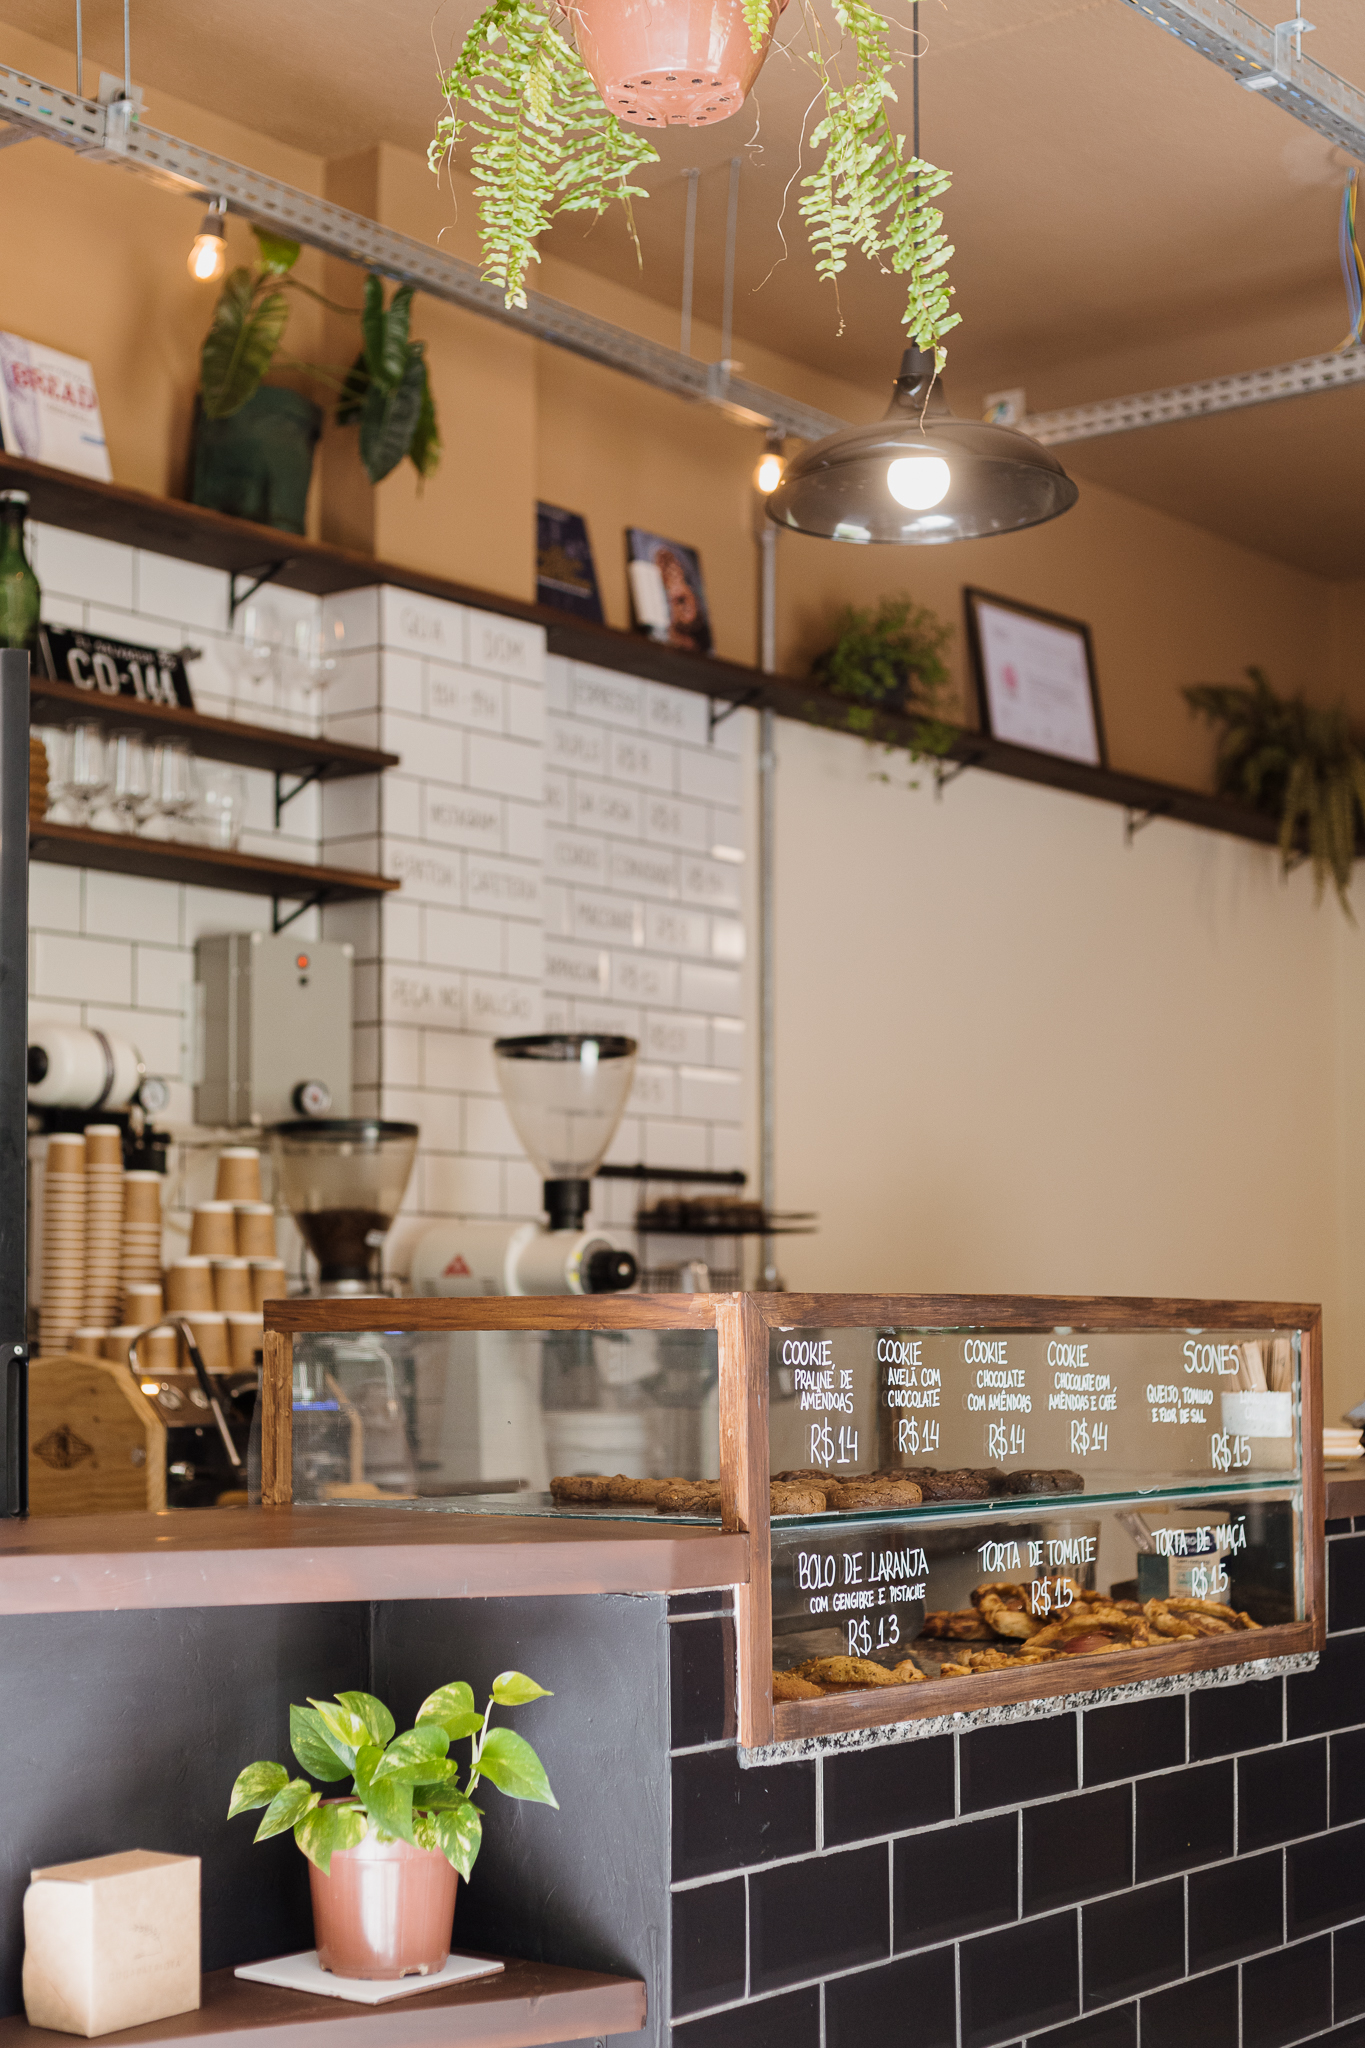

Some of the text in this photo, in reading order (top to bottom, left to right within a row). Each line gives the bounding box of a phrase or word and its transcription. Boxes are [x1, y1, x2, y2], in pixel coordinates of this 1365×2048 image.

[11, 361, 98, 412] BREAD
[782, 1339, 833, 1366] COOKIE
[877, 1338, 922, 1366] COOKIE
[964, 1338, 1008, 1365] COOKIE
[1047, 1340, 1090, 1368] COOKIE
[1183, 1339, 1240, 1376] SCONES
[840, 1368, 854, 1390] DE
[887, 1367, 941, 1387] AVELÃ COM
[976, 1369, 1026, 1389] CHOCOLATE
[1054, 1371, 1111, 1392] CHOCOLATE COM
[800, 1387, 854, 1414] AMÊNDOAS
[887, 1388, 941, 1408] CHOCOLATE
[967, 1389, 1032, 1413] COM AMÊNDOAS
[1048, 1386, 1118, 1412] AMÊNDOAS E CAFÉ
[1181, 1386, 1214, 1405] TOMILHO
[1151, 1406, 1207, 1425] E FLOR DE SAL
[978, 1535, 1097, 1573] TORTA DE TOMATE
[1151, 1527, 1188, 1557] TORTA
[1196, 1525, 1211, 1553] DE
[798, 1547, 930, 1590] BOLO DE LARANJA
[809, 1582, 926, 1614] COM GENGIBRE E PISTACHE
